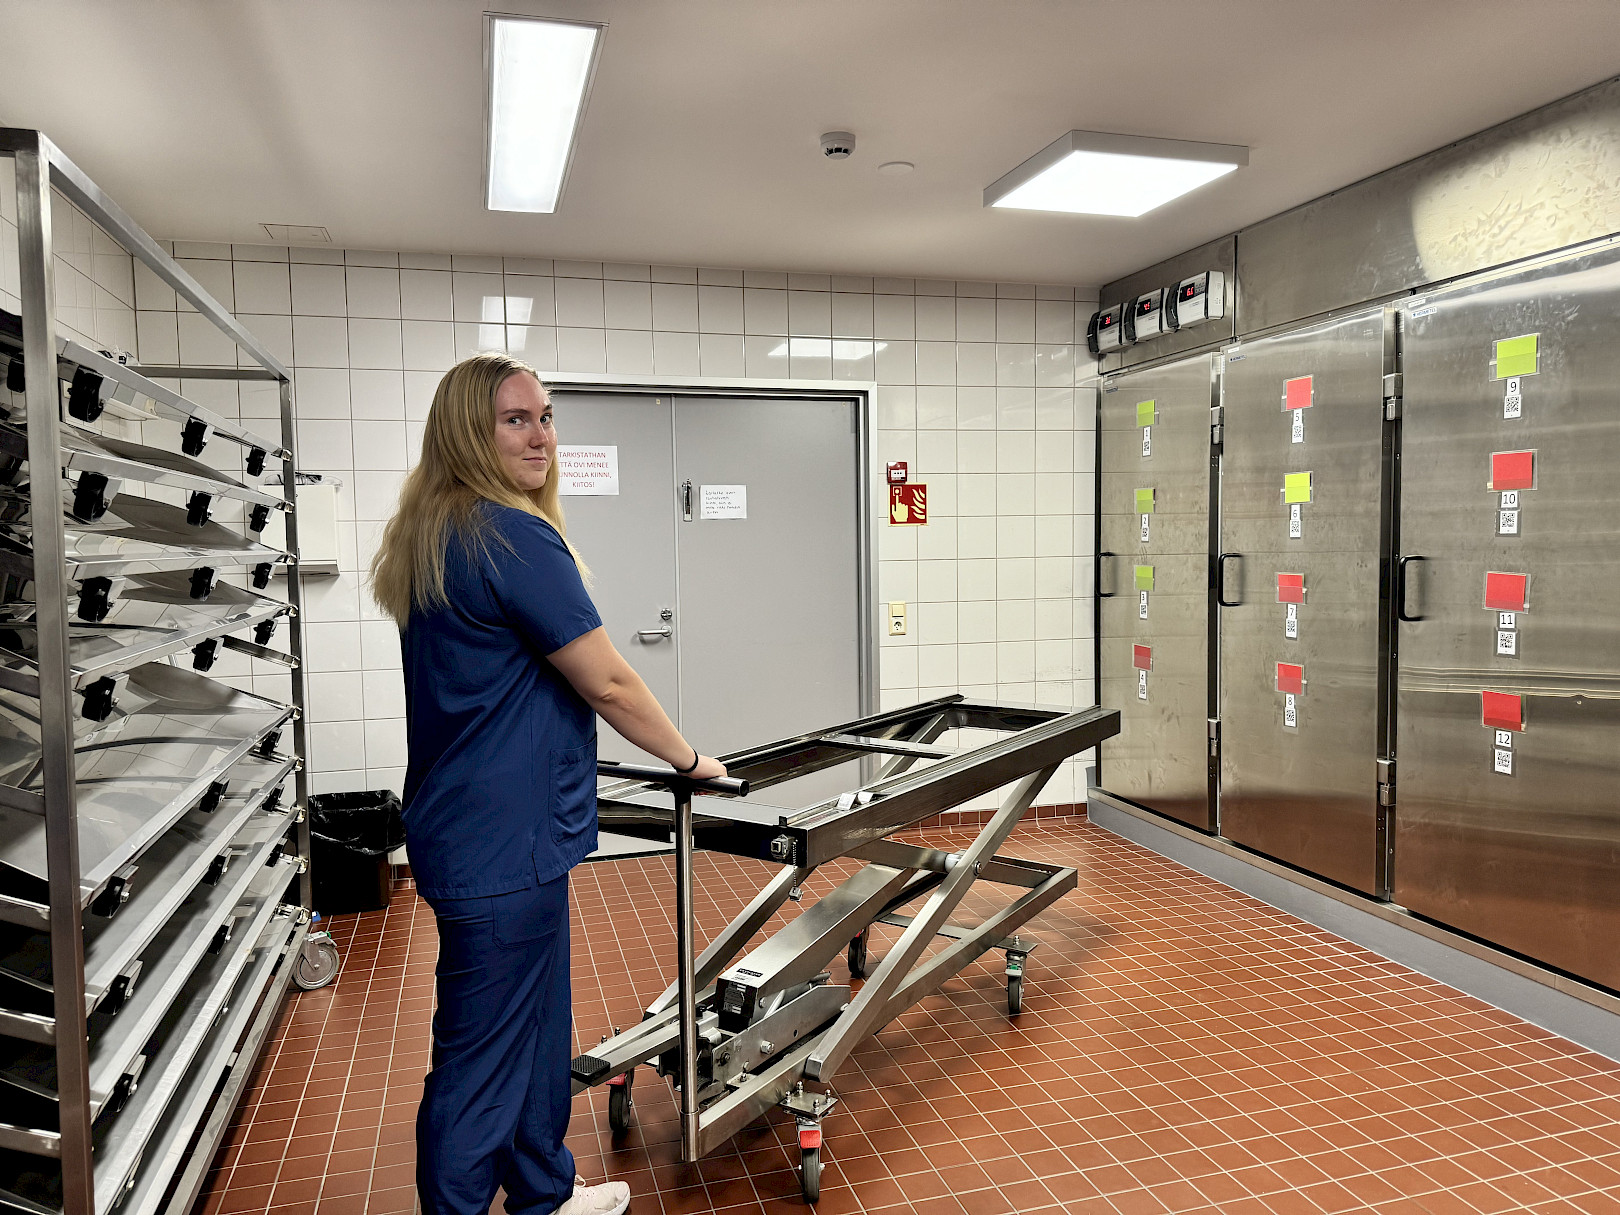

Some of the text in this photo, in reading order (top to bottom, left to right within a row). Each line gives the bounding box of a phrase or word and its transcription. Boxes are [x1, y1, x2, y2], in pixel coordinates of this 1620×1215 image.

[1510, 381, 1517, 393] 9
[1295, 412, 1300, 422] 5
[558, 451, 606, 459] TARKISTATHAN
[1503, 493, 1516, 504] 10
[1293, 509, 1298, 518] 6
[1290, 607, 1294, 616] 7
[1501, 614, 1513, 625] 11
[1288, 696, 1293, 705] 8
[1498, 733, 1510, 744] 12
